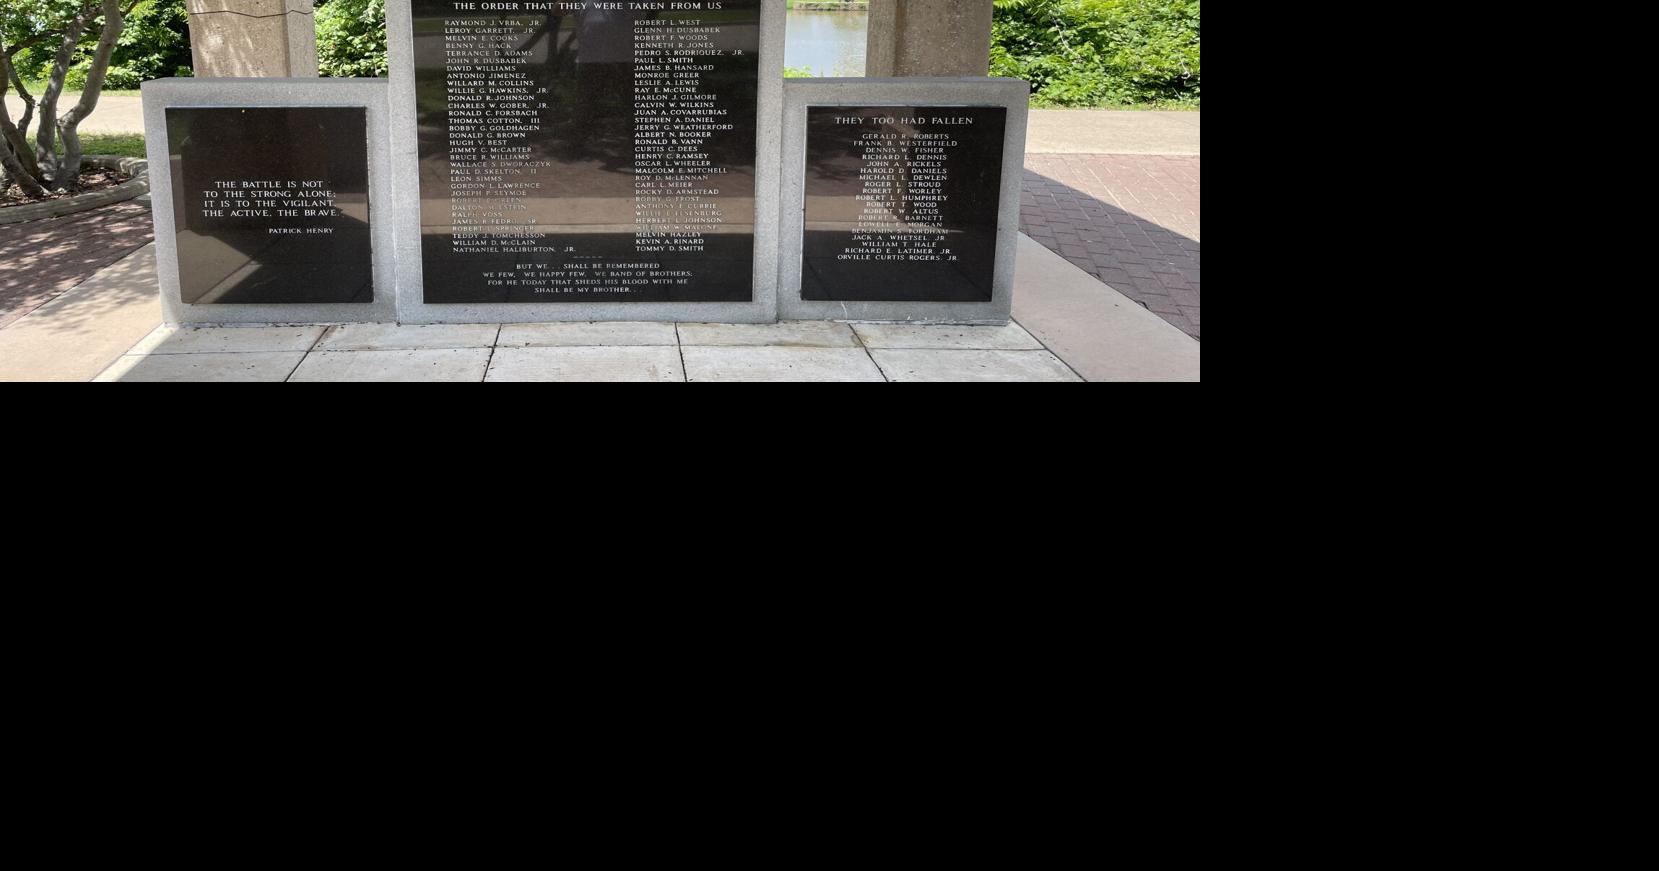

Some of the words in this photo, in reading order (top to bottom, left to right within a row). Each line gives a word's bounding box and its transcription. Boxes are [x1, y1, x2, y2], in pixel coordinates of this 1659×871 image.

[453, 2, 476, 10] THE
[481, 2, 519, 10] ORDER
[524, 2, 552, 10] THAT
[559, 2, 587, 10] THEY
[593, 2, 623, 10] WERE
[628, 2, 664, 10] TAKEN
[670, 2, 701, 10] FROM
[707, 2, 722, 10] US
